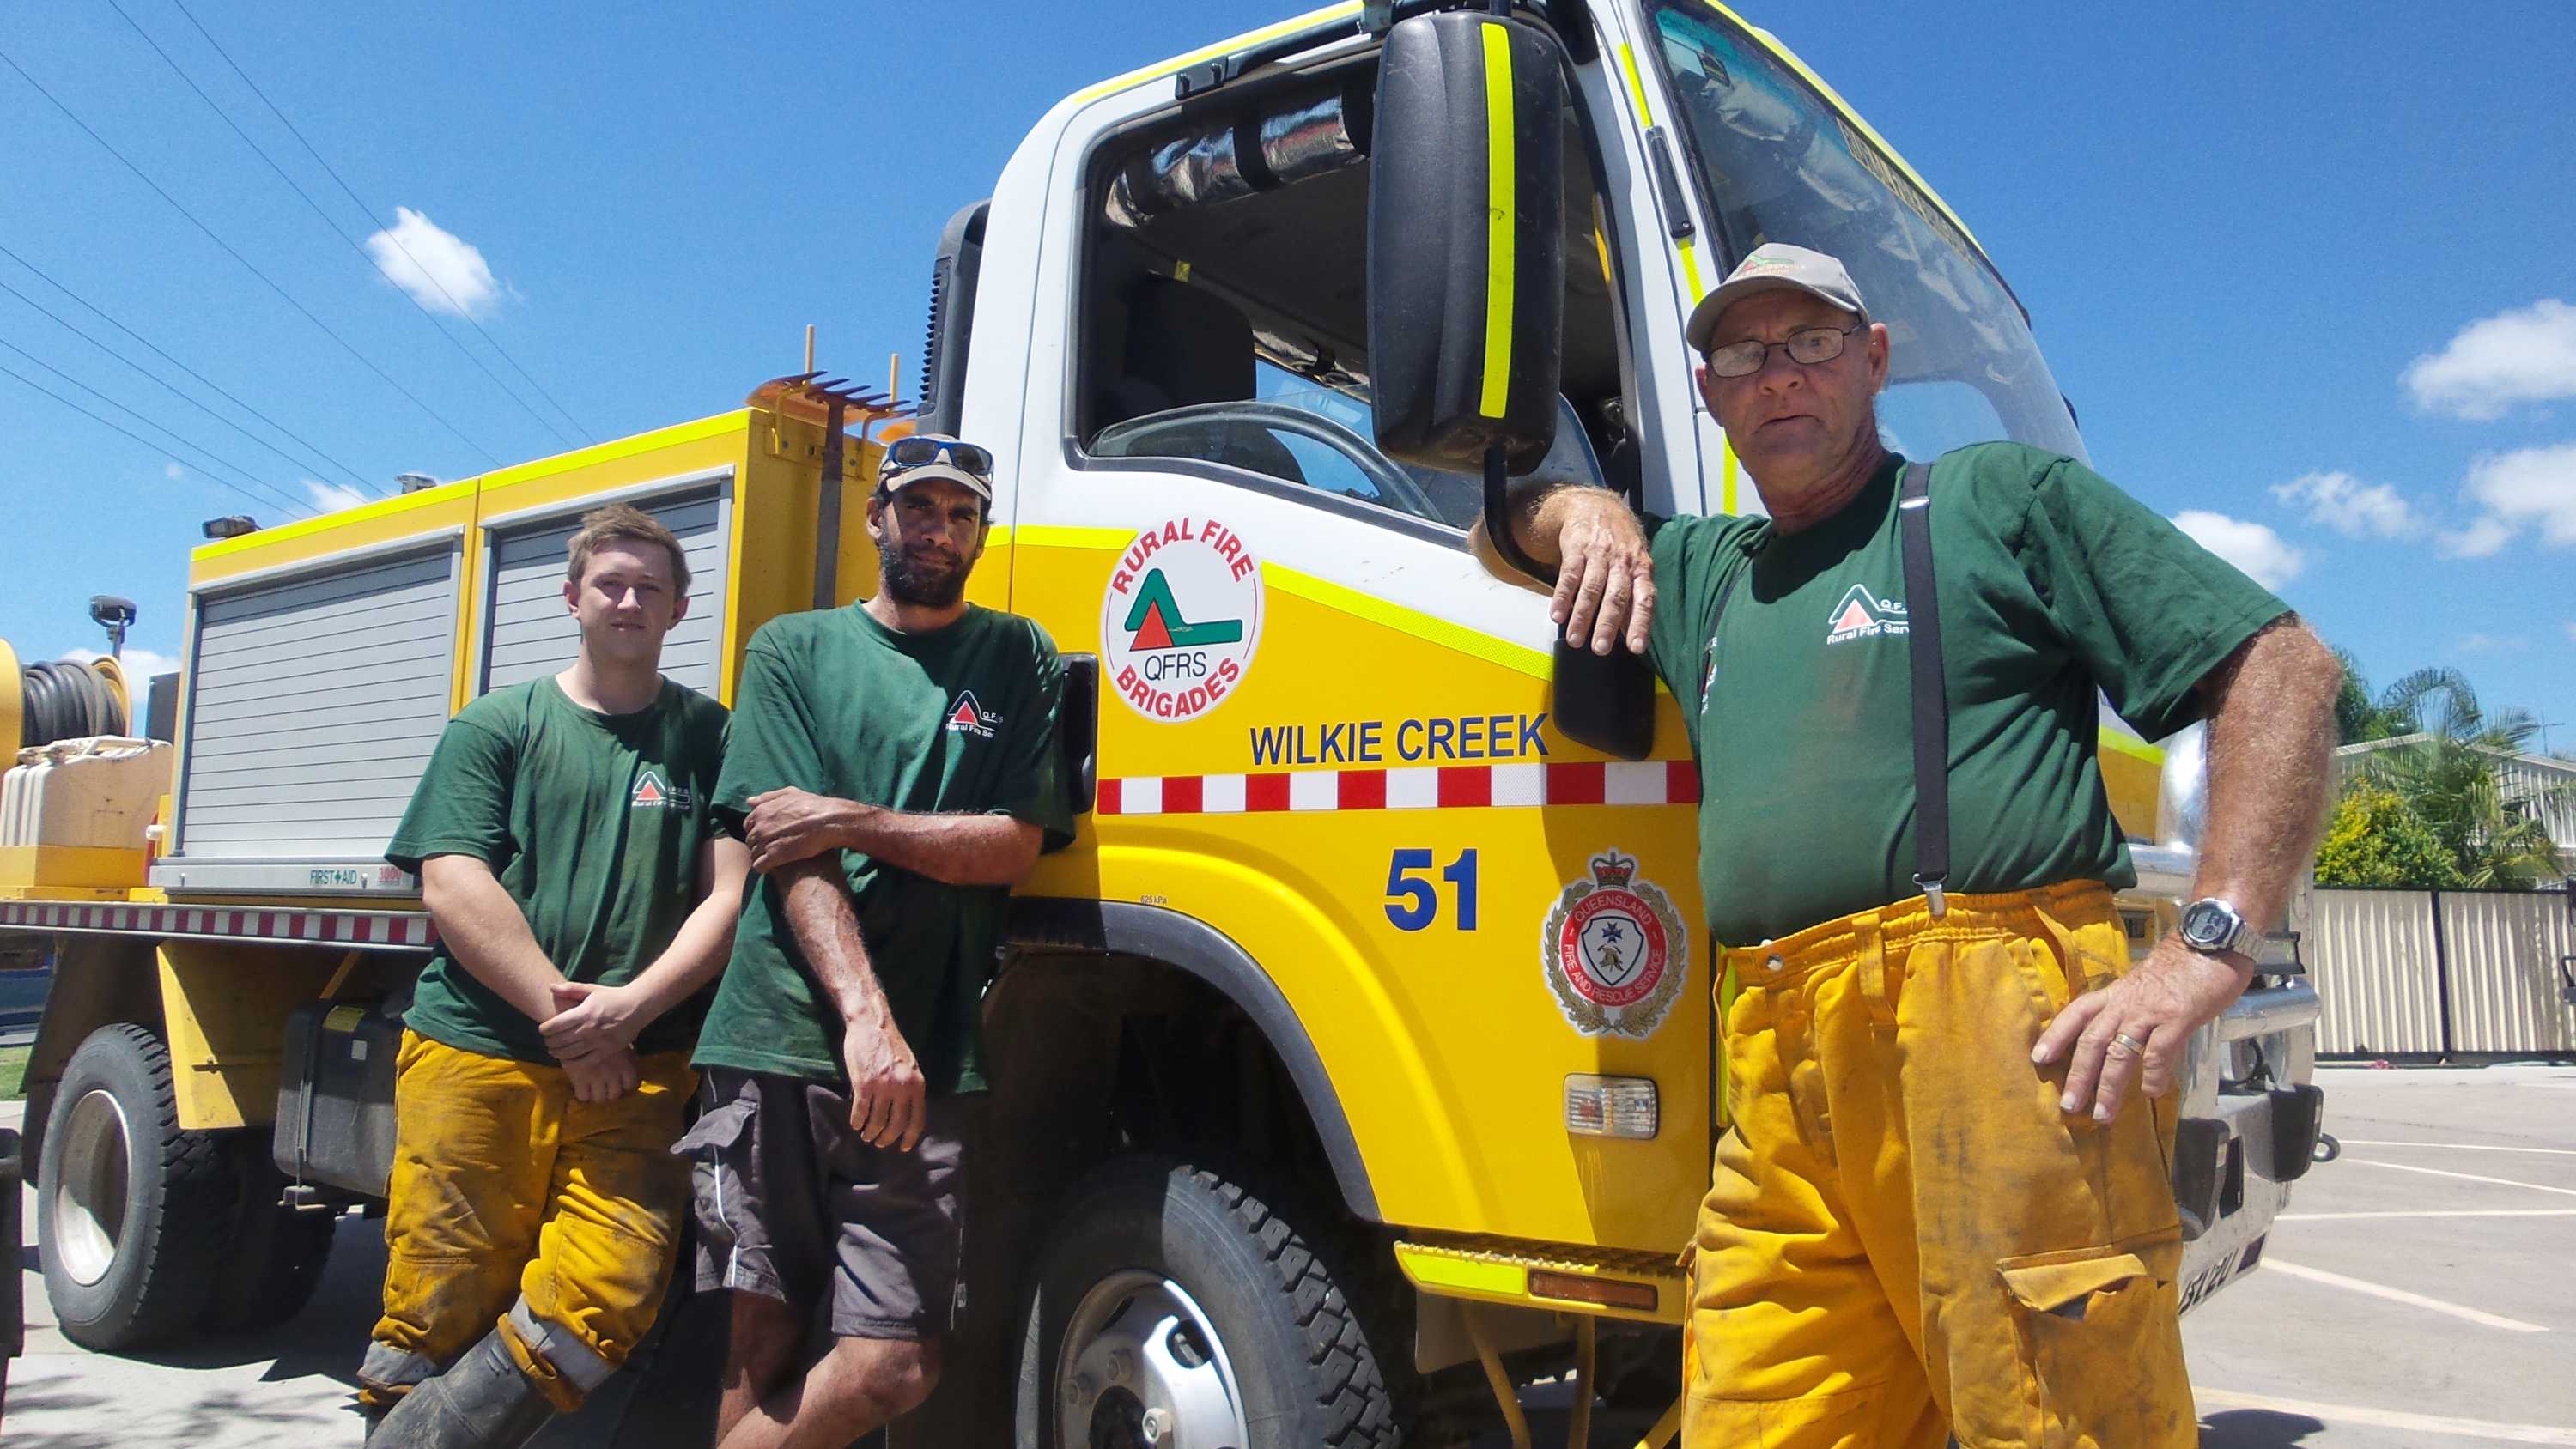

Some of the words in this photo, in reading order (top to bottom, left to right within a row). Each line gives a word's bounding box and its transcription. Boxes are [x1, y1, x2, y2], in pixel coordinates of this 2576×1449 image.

[1112, 518, 1194, 595] RURAL
[1200, 519, 1255, 583] FIRE
[1826, 625, 1857, 645] Rural
[1859, 627, 1881, 638] Fire
[1116, 657, 1240, 718] BRIGADES
[1145, 652, 1207, 681] QFRS
[1249, 720, 1382, 766] WILKIE
[1396, 712, 1549, 761] CREEK
[310, 870, 335, 885] FIRST
[342, 870, 357, 884] AID
[1383, 847, 1478, 931] 51
[1574, 894, 1653, 925] QUEENSLAND
[1564, 943, 1578, 969] FIRE
[1571, 971, 1593, 991] AND
[1592, 986, 1636, 1003] RESCUE
[1637, 949, 1663, 994] SERVICE
